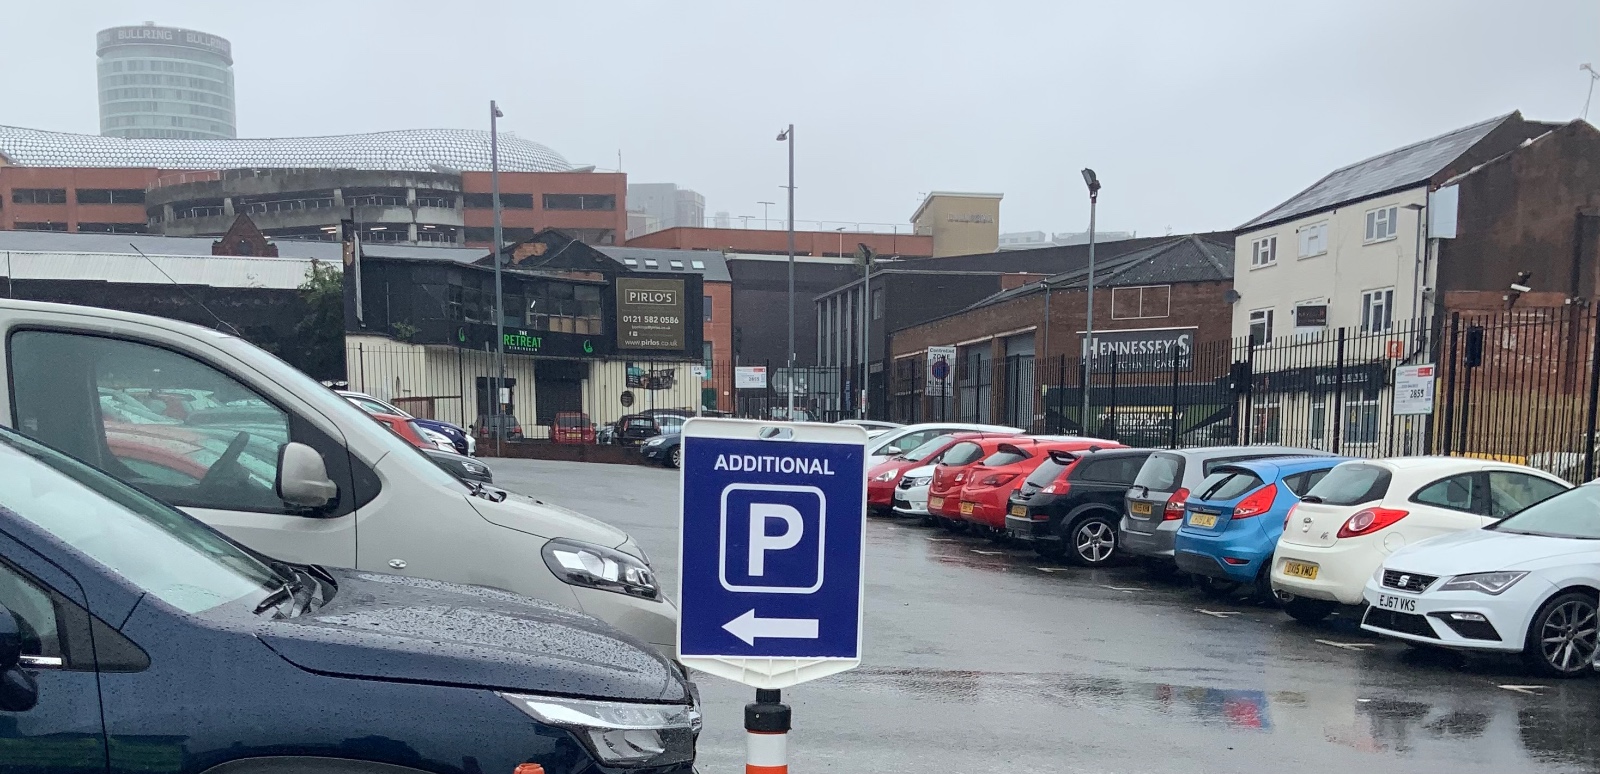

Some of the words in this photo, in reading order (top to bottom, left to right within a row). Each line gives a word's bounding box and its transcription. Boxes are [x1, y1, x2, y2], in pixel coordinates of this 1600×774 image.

[118, 29, 173, 40] BULLRING
[630, 291, 672, 303] PIRLO'S
[623, 315, 641, 323] 0121
[644, 315, 659, 324] 582
[660, 316, 679, 324] 0586
[503, 334, 543, 348] RETREAT
[714, 454, 835, 476] ADDITIONAL
[748, 502, 804, 577] P
[1379, 594, 1399, 609] EJ67
[1400, 598, 1416, 612] VKS
